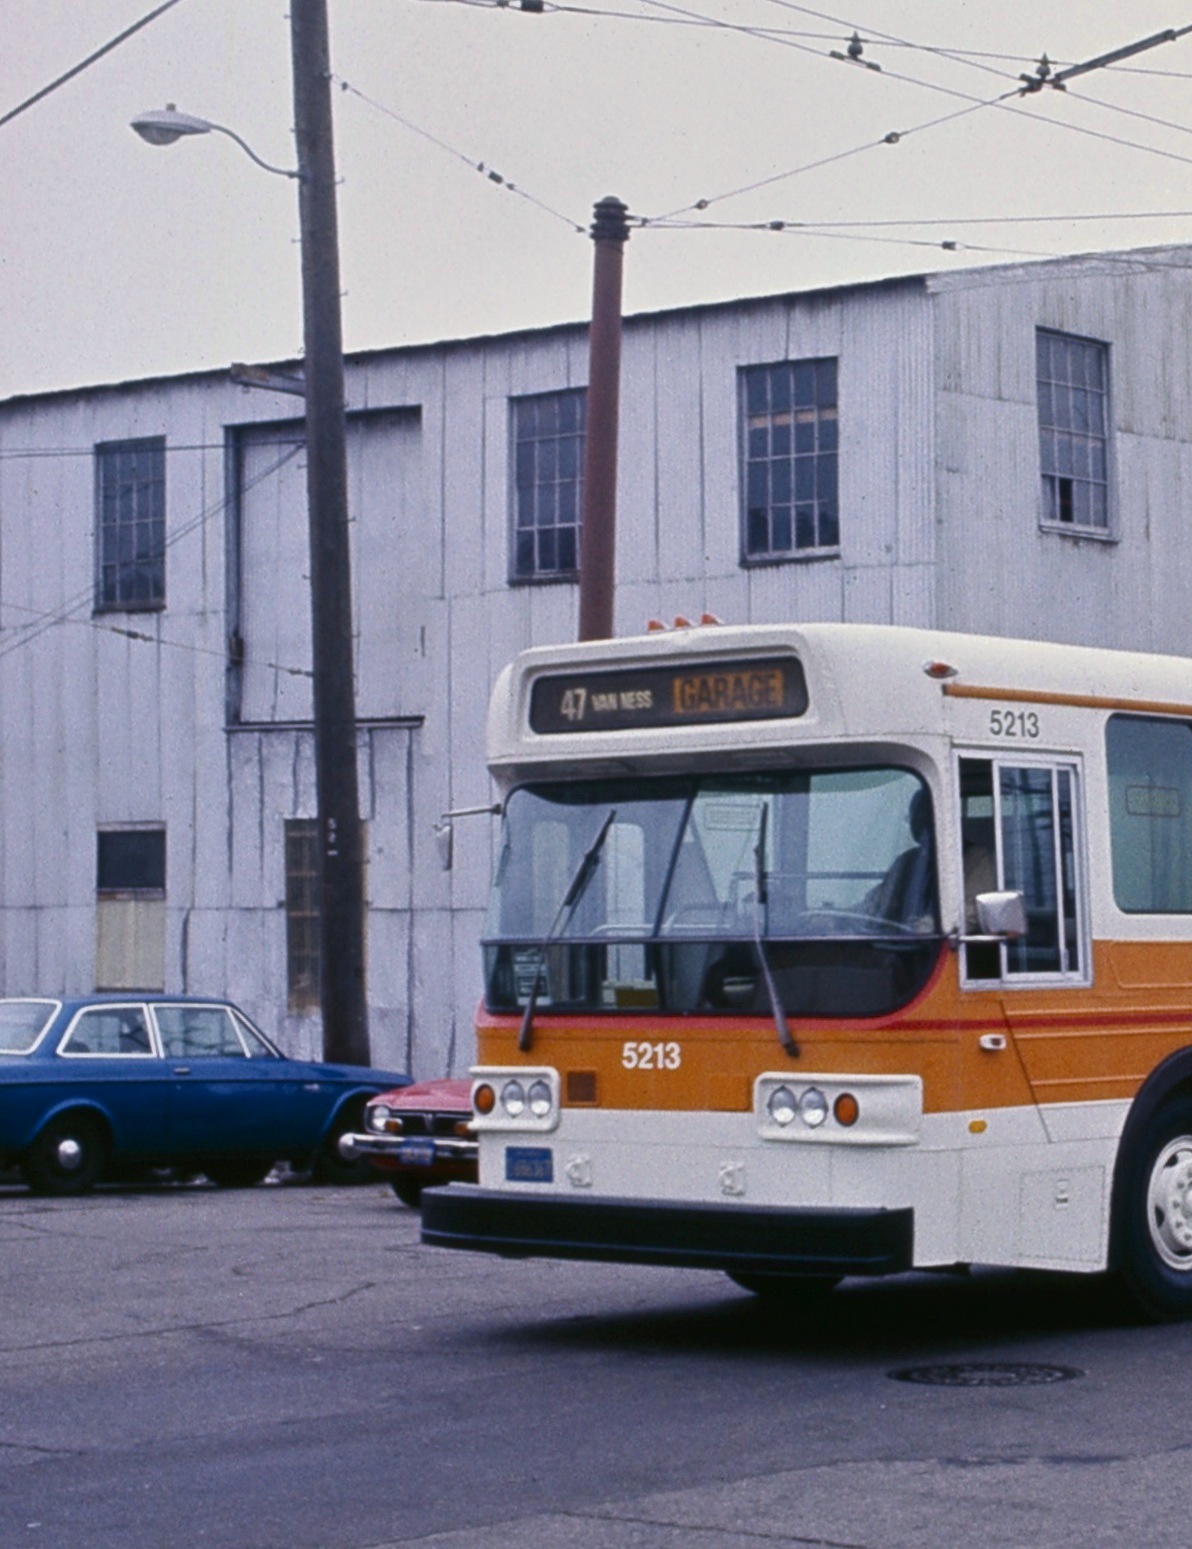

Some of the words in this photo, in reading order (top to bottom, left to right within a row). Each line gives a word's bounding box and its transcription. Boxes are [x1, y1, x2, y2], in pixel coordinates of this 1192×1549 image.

[560, 688, 587, 720] 47
[592, 693, 617, 711] VAN
[620, 690, 653, 709] NESS
[677, 671, 780, 713] GARAGE
[990, 710, 1039, 738] 5213
[622, 1041, 681, 1069] 5213
